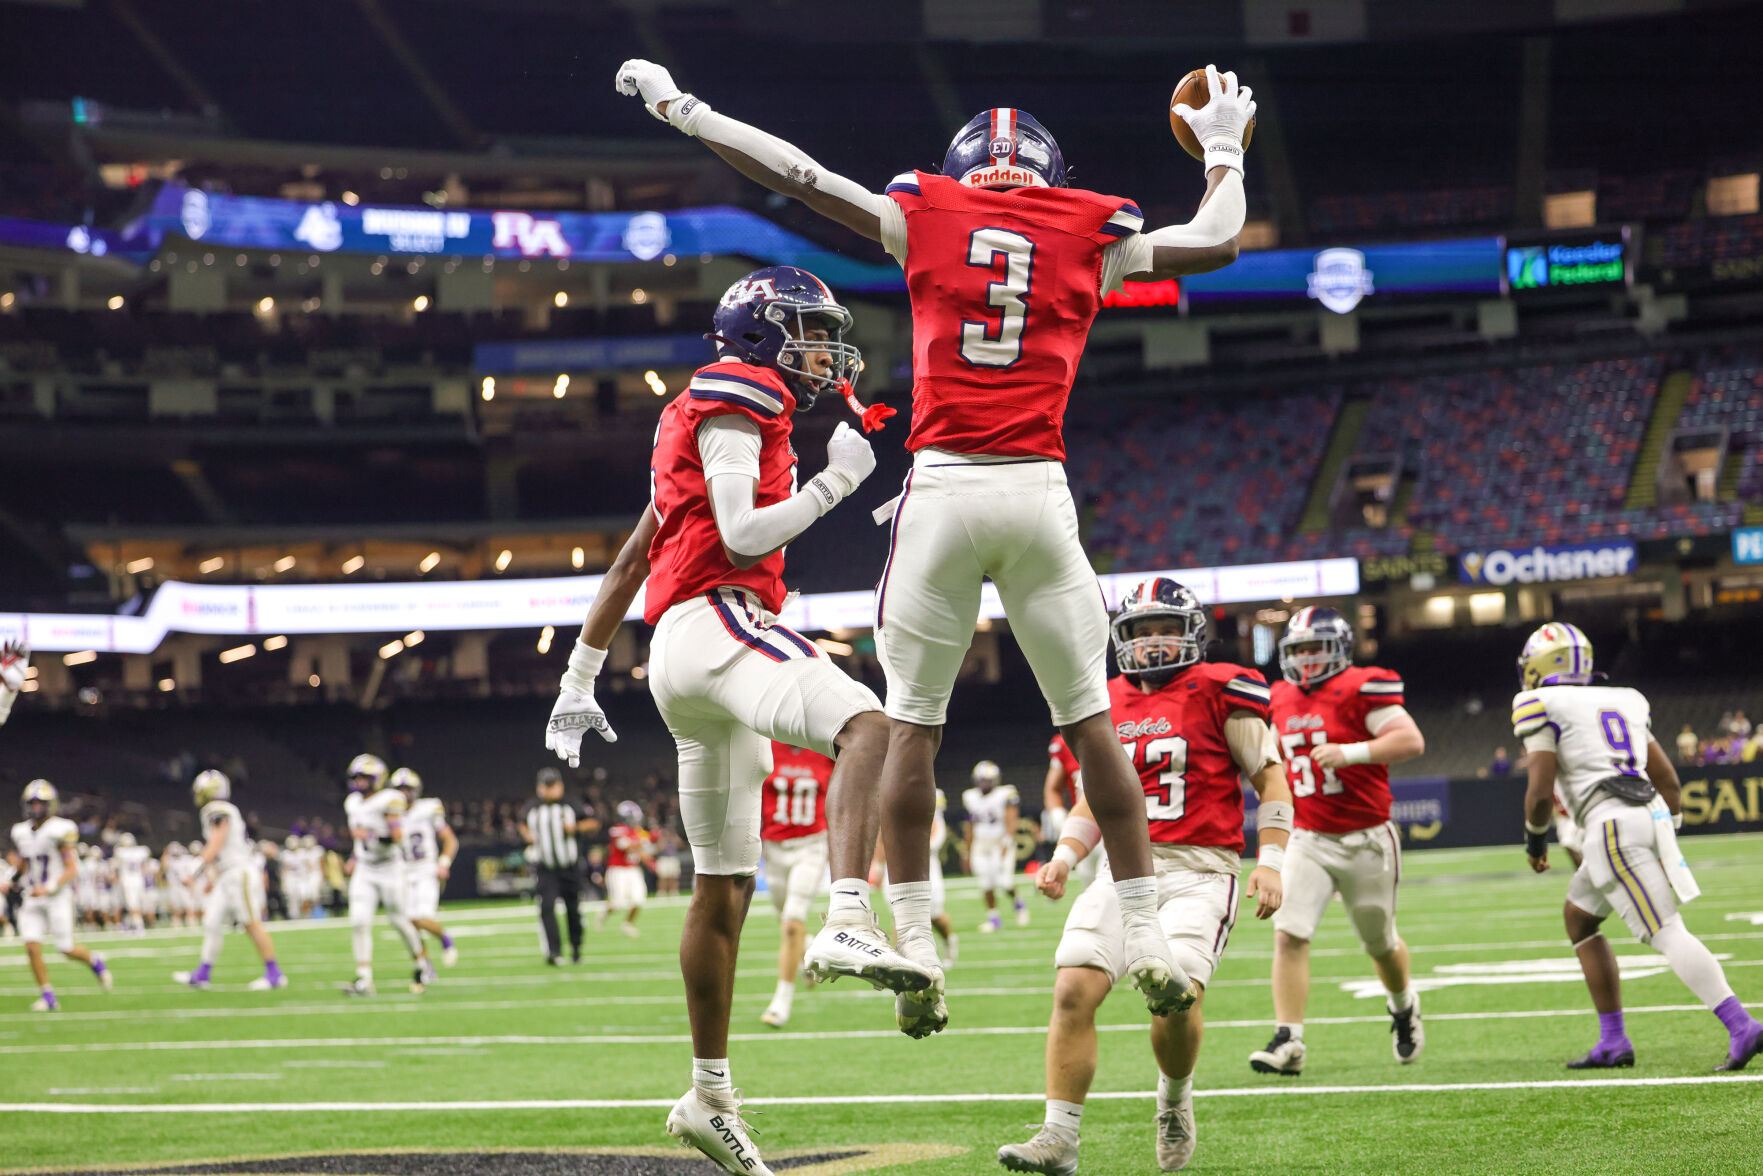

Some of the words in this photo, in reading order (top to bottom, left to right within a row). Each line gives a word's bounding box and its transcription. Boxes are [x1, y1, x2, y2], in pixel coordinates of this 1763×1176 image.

[992, 141, 1010, 153] ED
[970, 169, 1033, 184] Riddell
[958, 227, 1036, 369] 3
[813, 479, 834, 504] BATTLE
[1484, 546, 1634, 585] Ochsner
[550, 714, 605, 730] BATTLE
[1116, 717, 1172, 738] Rebels
[1598, 708, 1640, 777] 9
[1280, 730, 1344, 798] 51
[772, 776, 819, 826] 10
[833, 931, 885, 957] BATTLE
[709, 1115, 757, 1171] BATTLE
